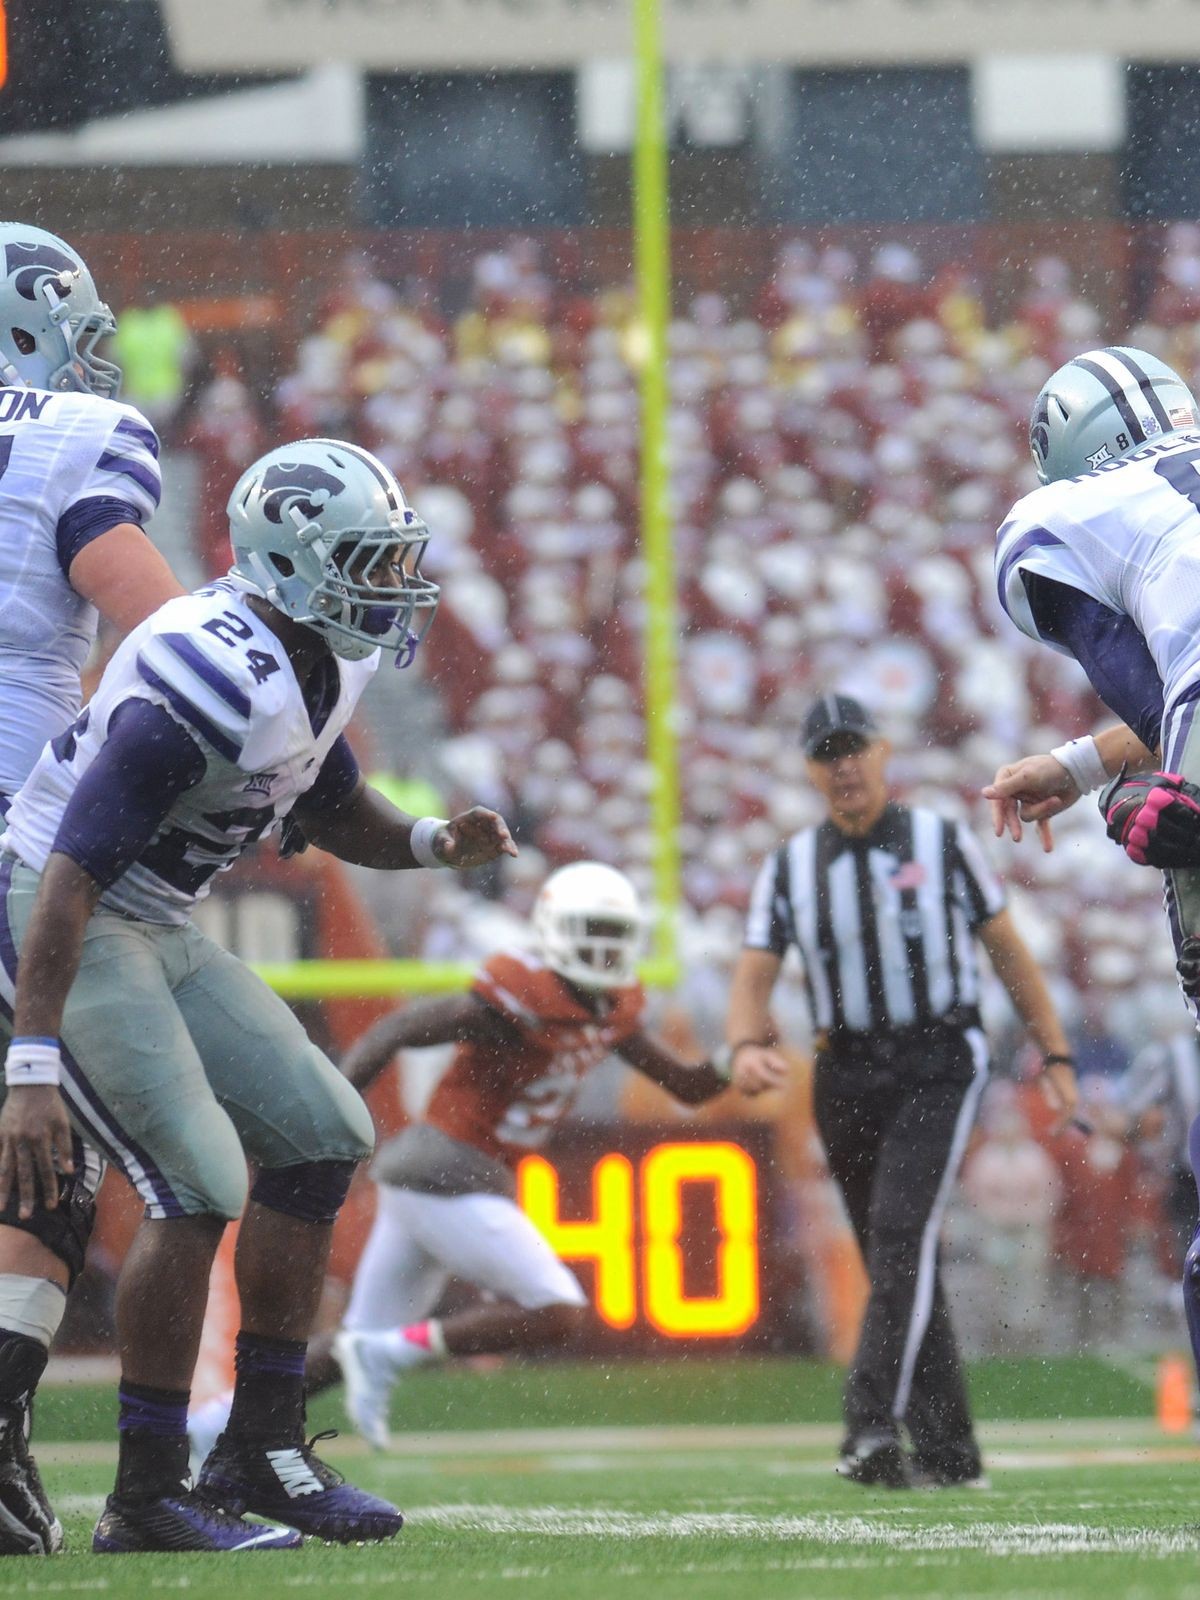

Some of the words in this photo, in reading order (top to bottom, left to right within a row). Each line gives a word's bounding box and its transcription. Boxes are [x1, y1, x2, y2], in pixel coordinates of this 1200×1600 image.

[1116, 433, 1129, 450] 8
[201, 611, 281, 685] 24
[517, 1142, 759, 1338] 40
[265, 1448, 325, 1499] NIKE
